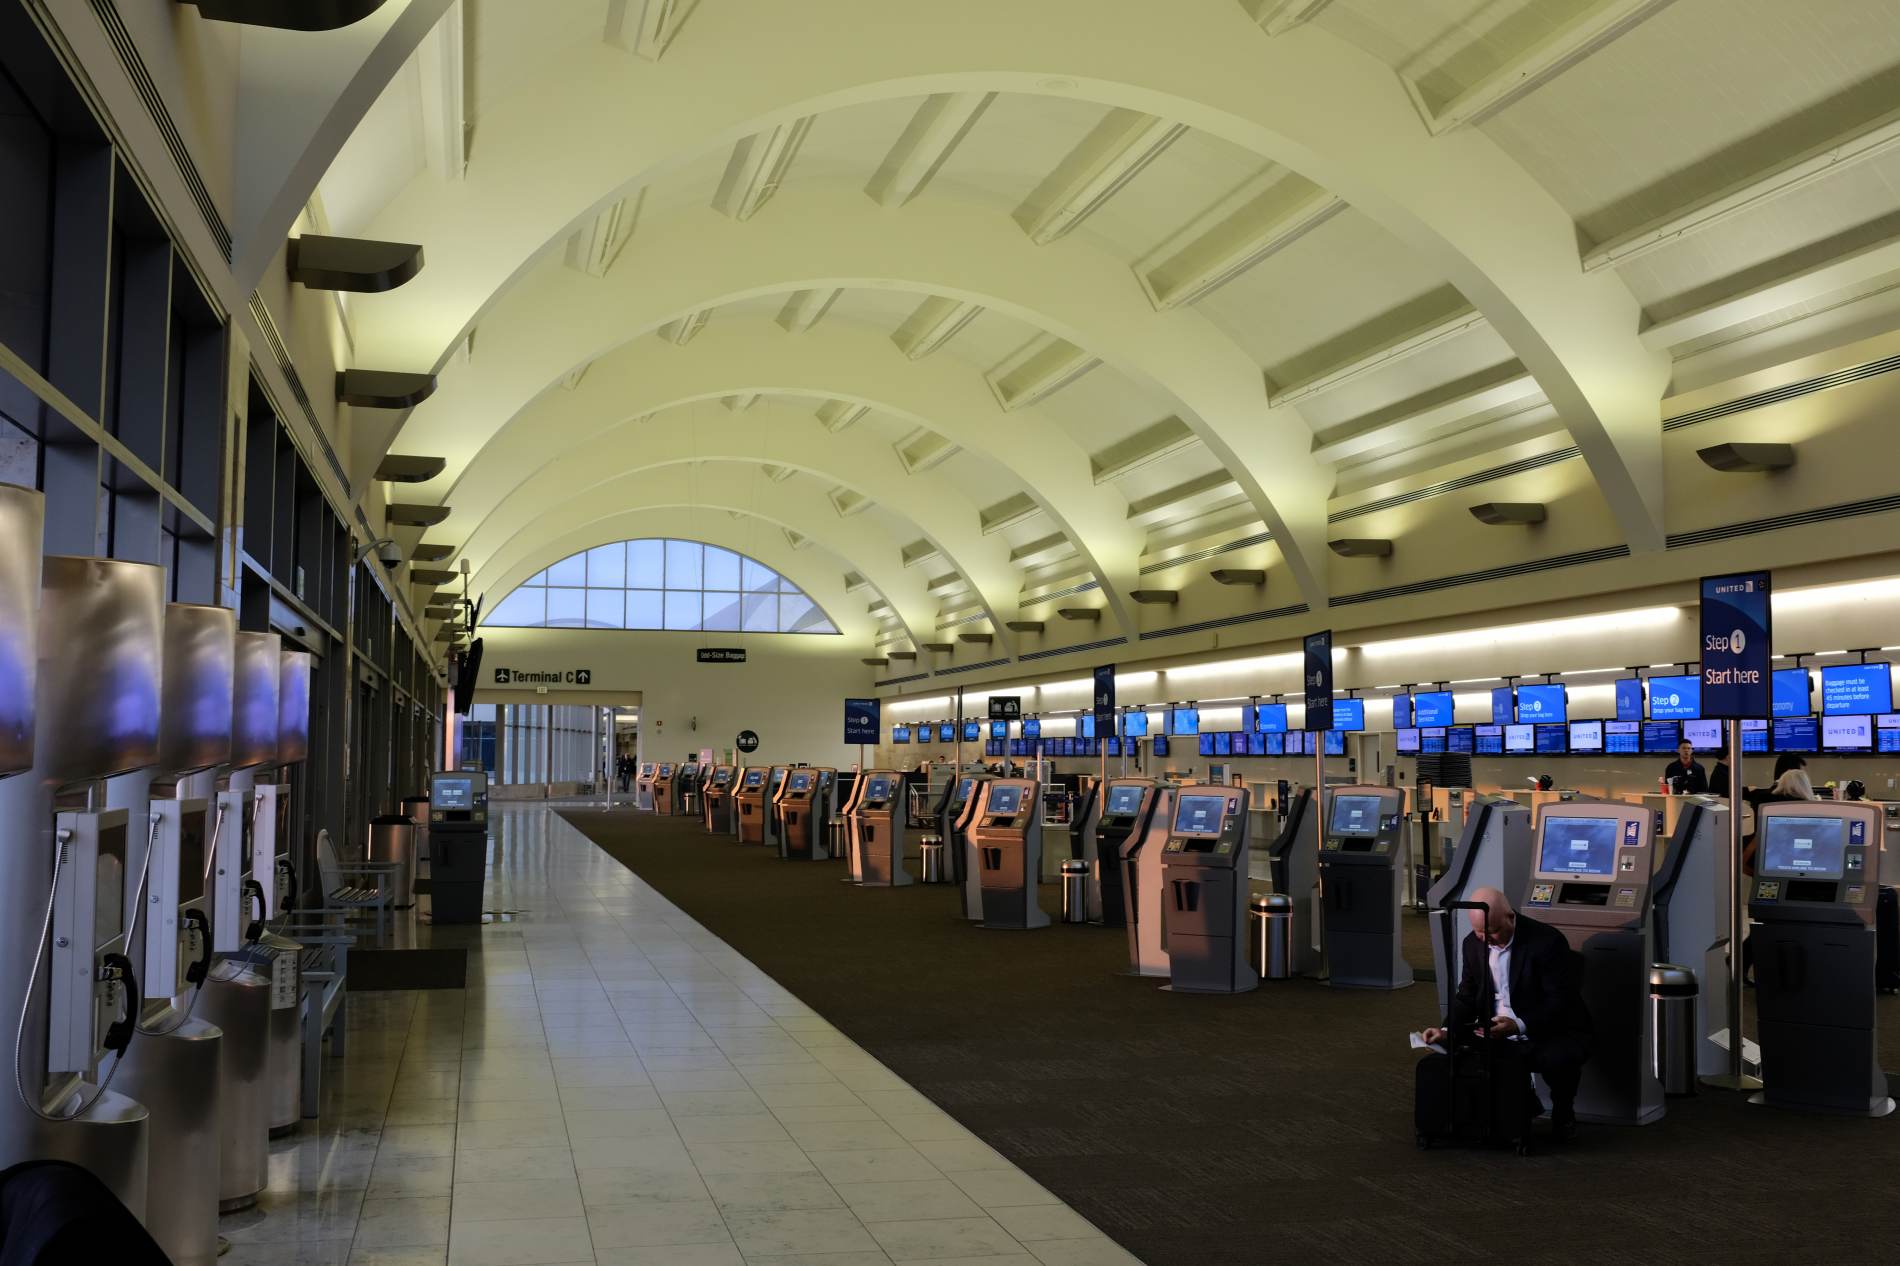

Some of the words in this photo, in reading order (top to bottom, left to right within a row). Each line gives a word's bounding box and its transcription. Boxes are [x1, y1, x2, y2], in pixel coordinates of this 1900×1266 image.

[1715, 584, 1745, 594] UNITED
[1705, 634, 1729, 652] Step
[512, 670, 562, 683] Terminal
[566, 671, 574, 683] C
[1705, 668, 1731, 685] Start
[1733, 667, 1760, 684] here
[1519, 702, 1533, 711] Step
[1652, 696, 1669, 706] Step
